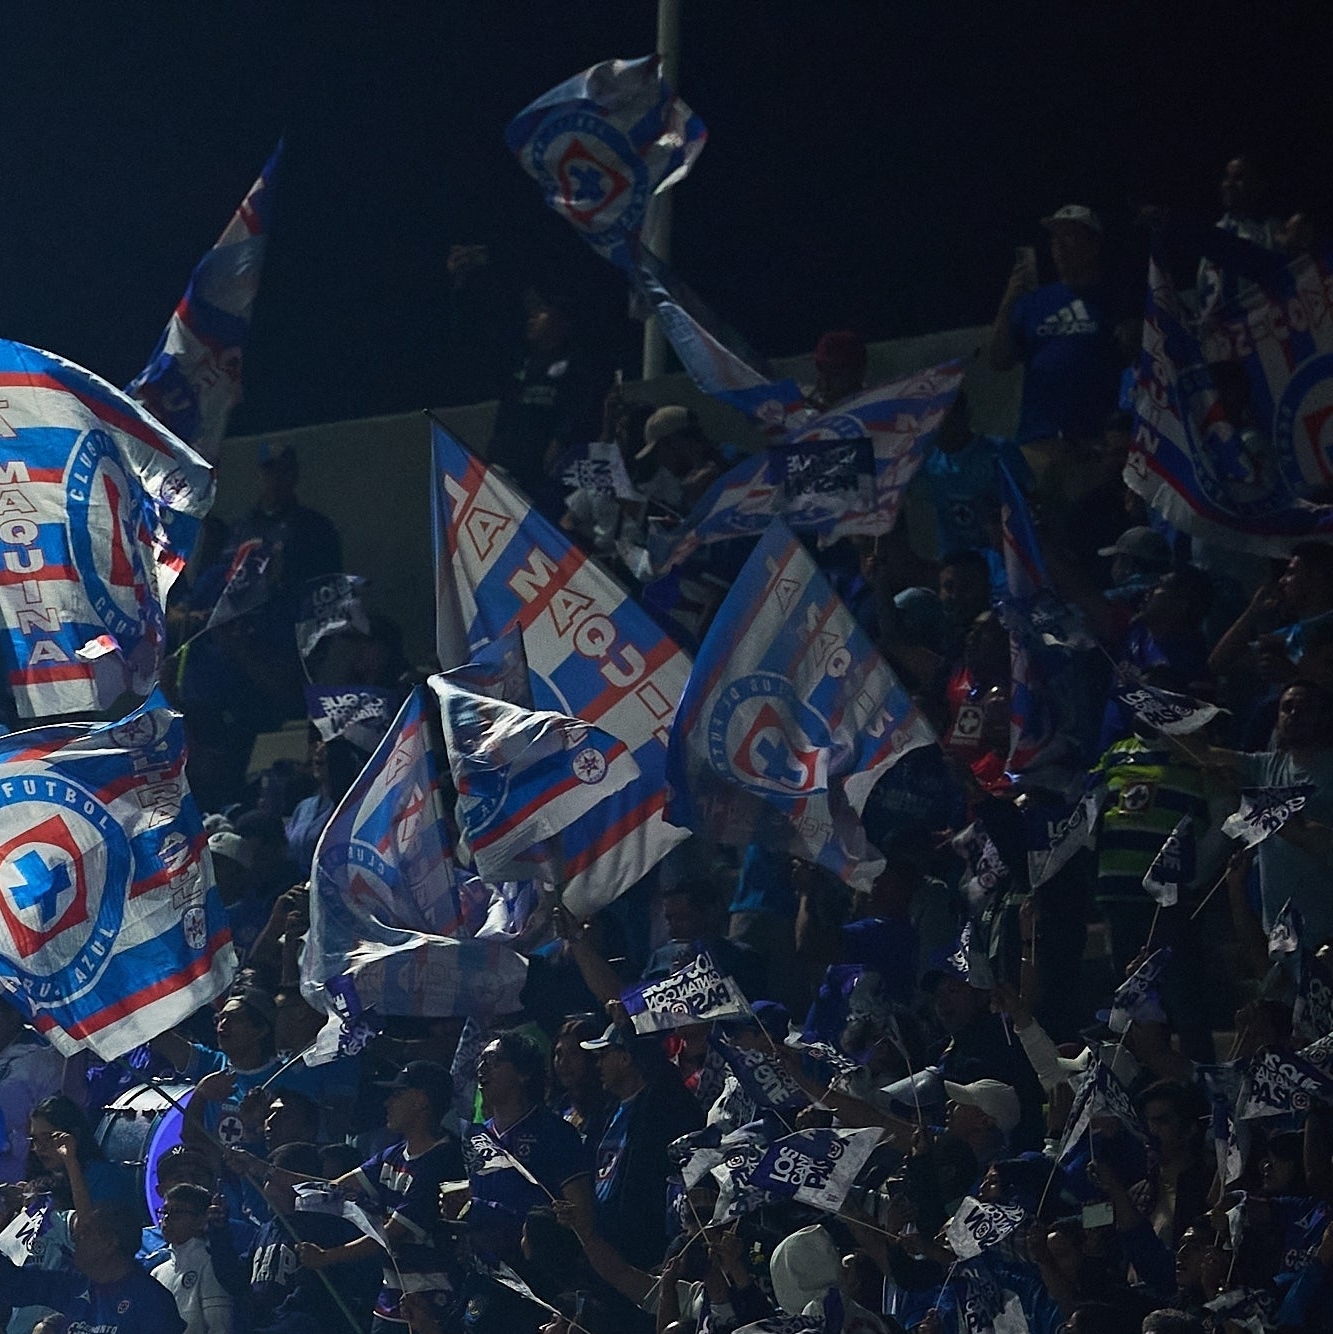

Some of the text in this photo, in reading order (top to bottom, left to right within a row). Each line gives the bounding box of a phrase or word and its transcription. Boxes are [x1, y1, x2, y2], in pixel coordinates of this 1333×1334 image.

[510, 547, 673, 723] MAQUI
[3, 778, 113, 829] FUTBOL
[74, 922, 117, 982] AZUL
[753, 1064, 790, 1105] QUE
[769, 1146, 800, 1183] LOS
